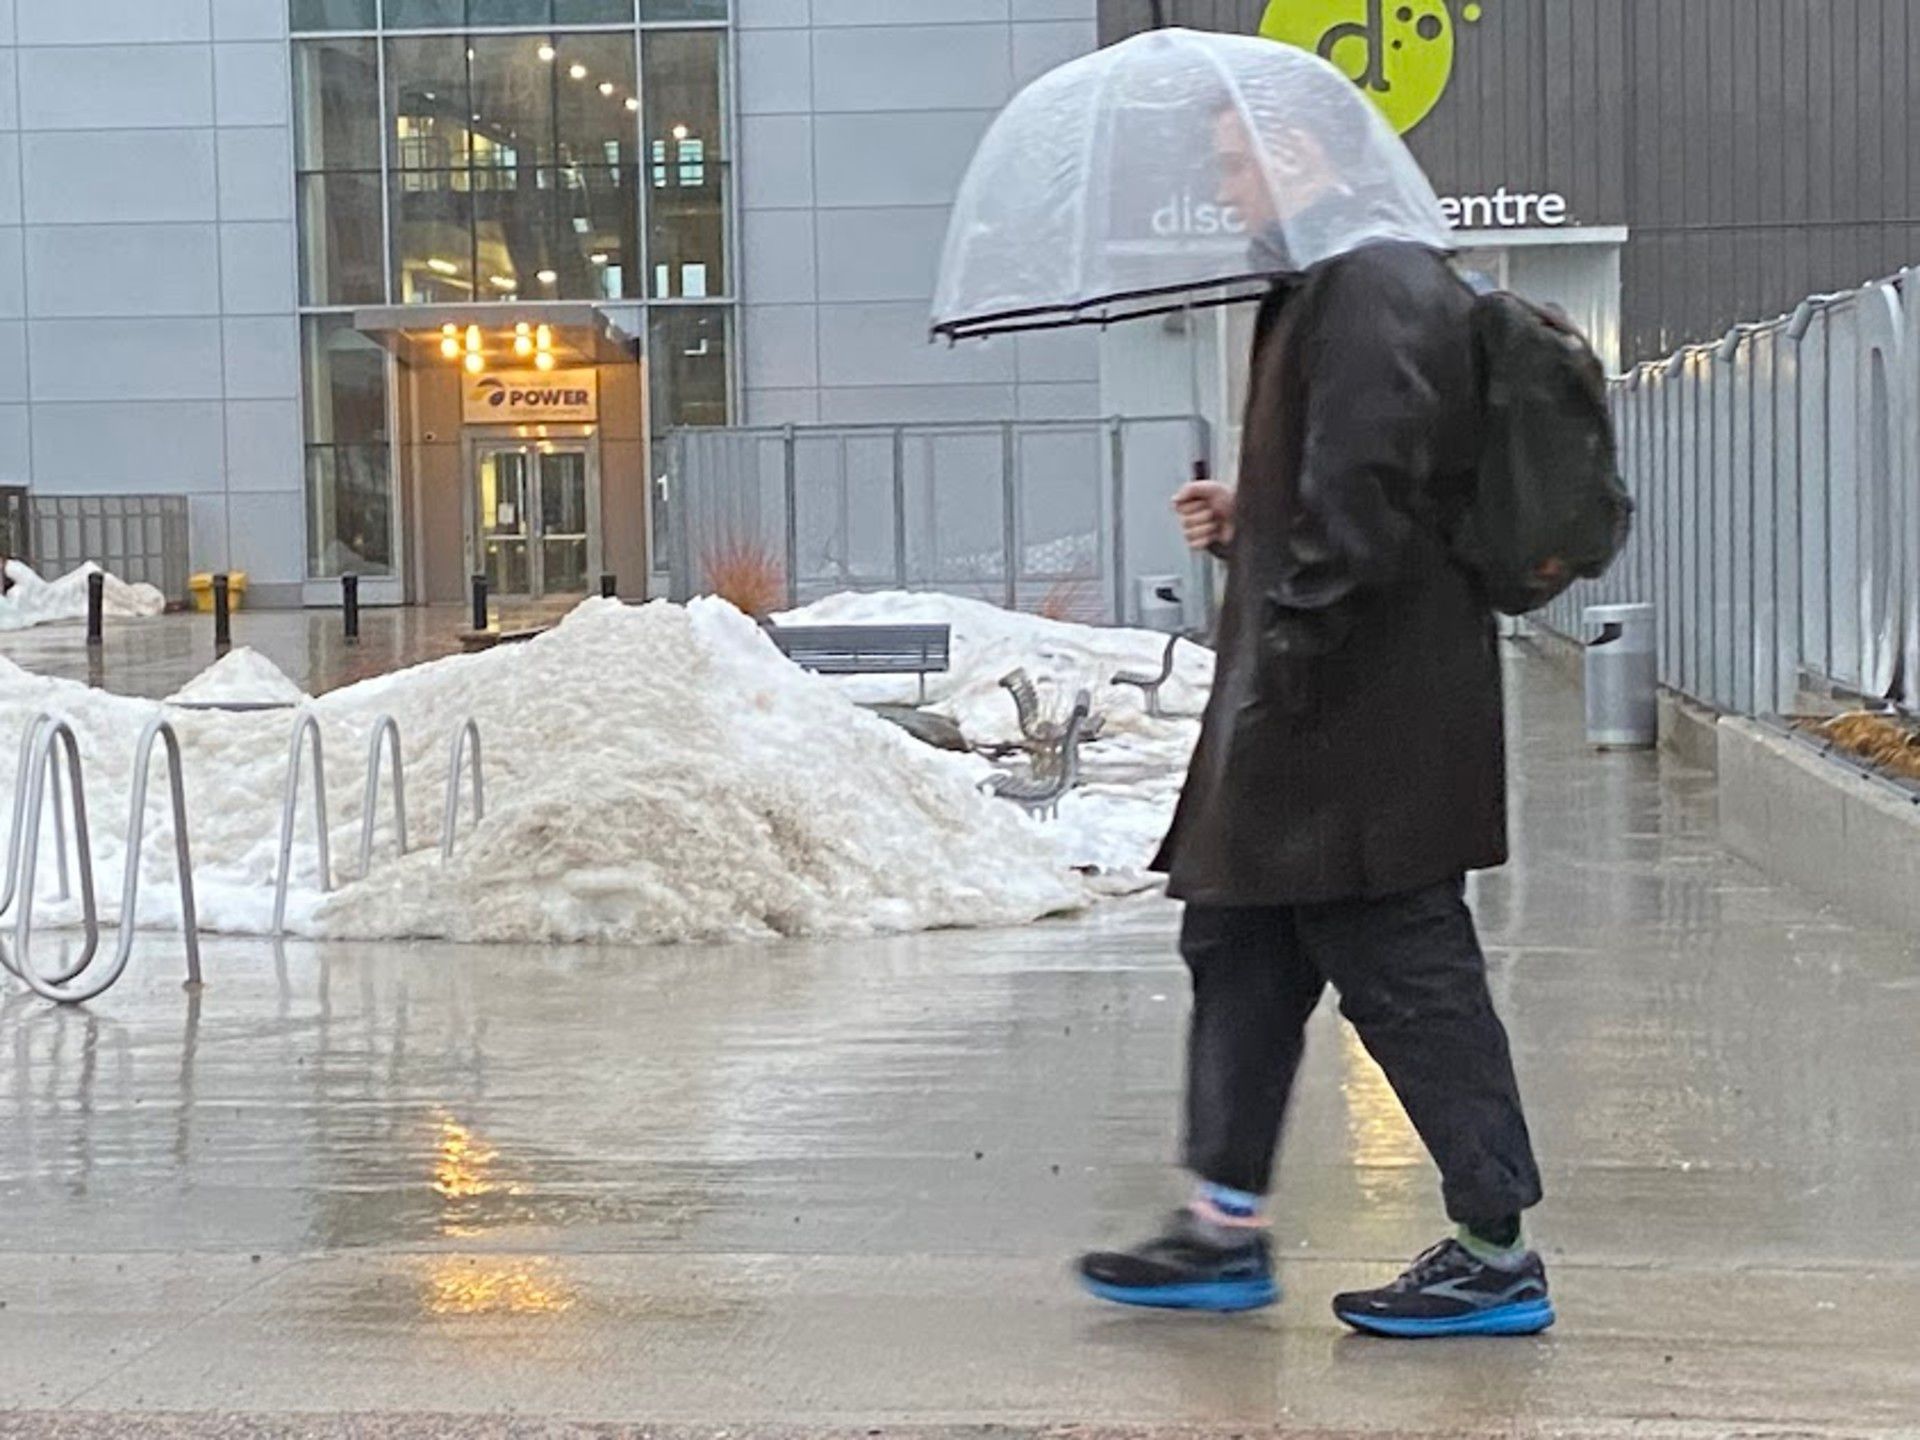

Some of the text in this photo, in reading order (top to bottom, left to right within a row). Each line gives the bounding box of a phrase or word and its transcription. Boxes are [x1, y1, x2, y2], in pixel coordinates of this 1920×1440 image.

[1151, 186, 1566, 235] disc entre
[509, 389, 589, 406] POWER
